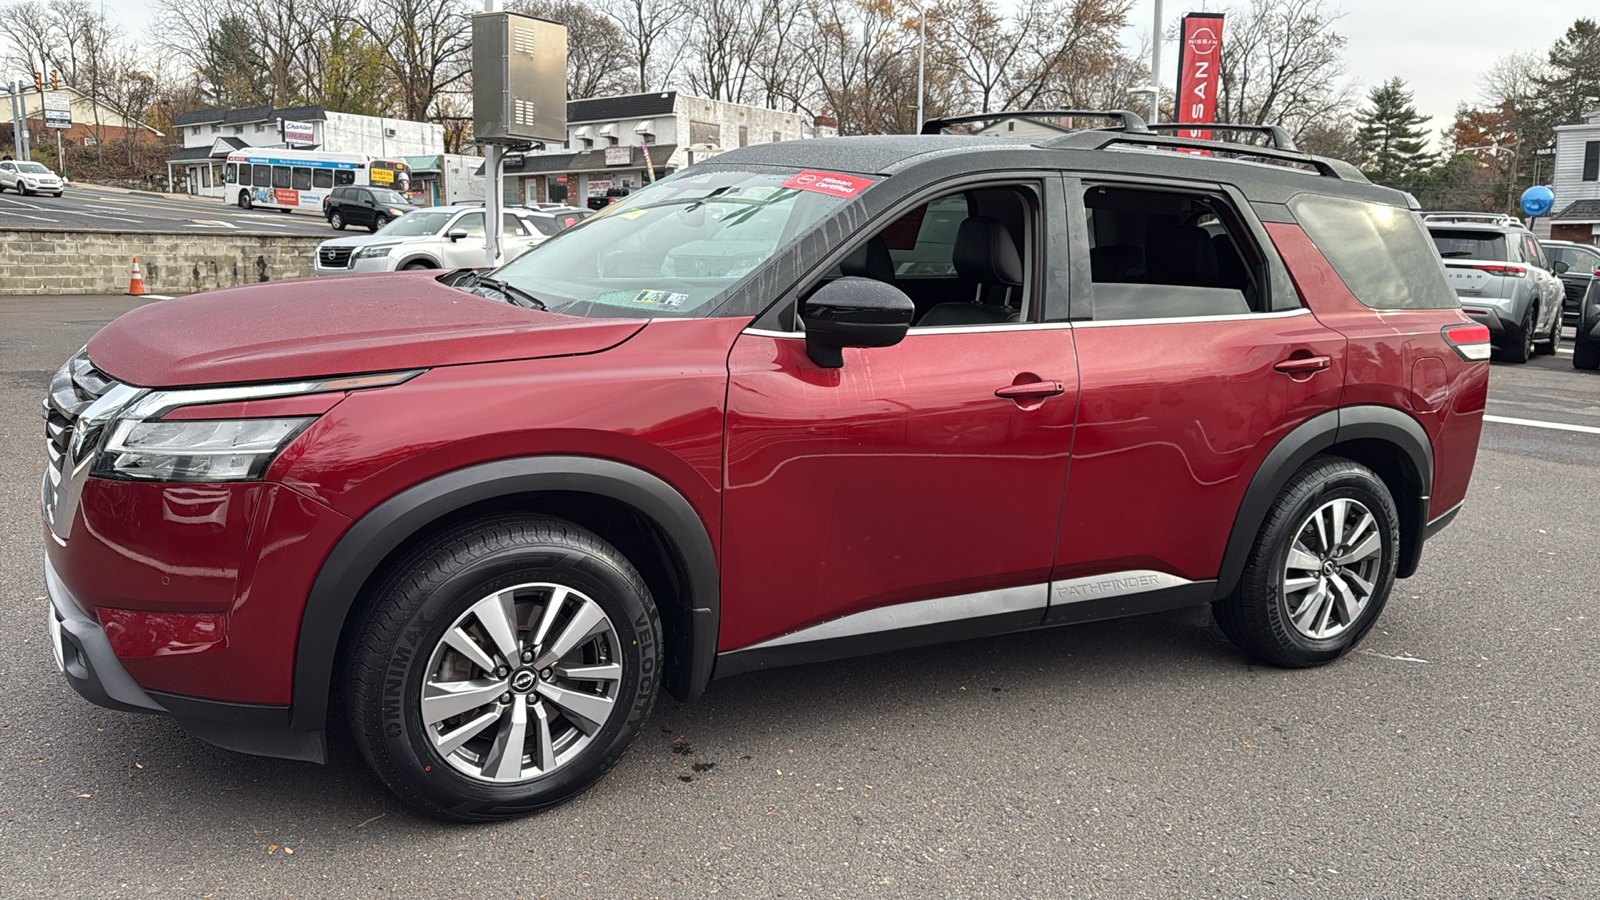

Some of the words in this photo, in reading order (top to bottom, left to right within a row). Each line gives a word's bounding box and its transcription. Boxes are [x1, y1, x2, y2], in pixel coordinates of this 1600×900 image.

[588, 182, 611, 190] COMPUTERS
[815, 182, 855, 193] Certified
[822, 177, 853, 187] Nissan
[1056, 574, 1160, 598] PATHFINDER
[384, 610, 434, 738] OMNIMAX
[627, 612, 654, 728] VELOCITY
